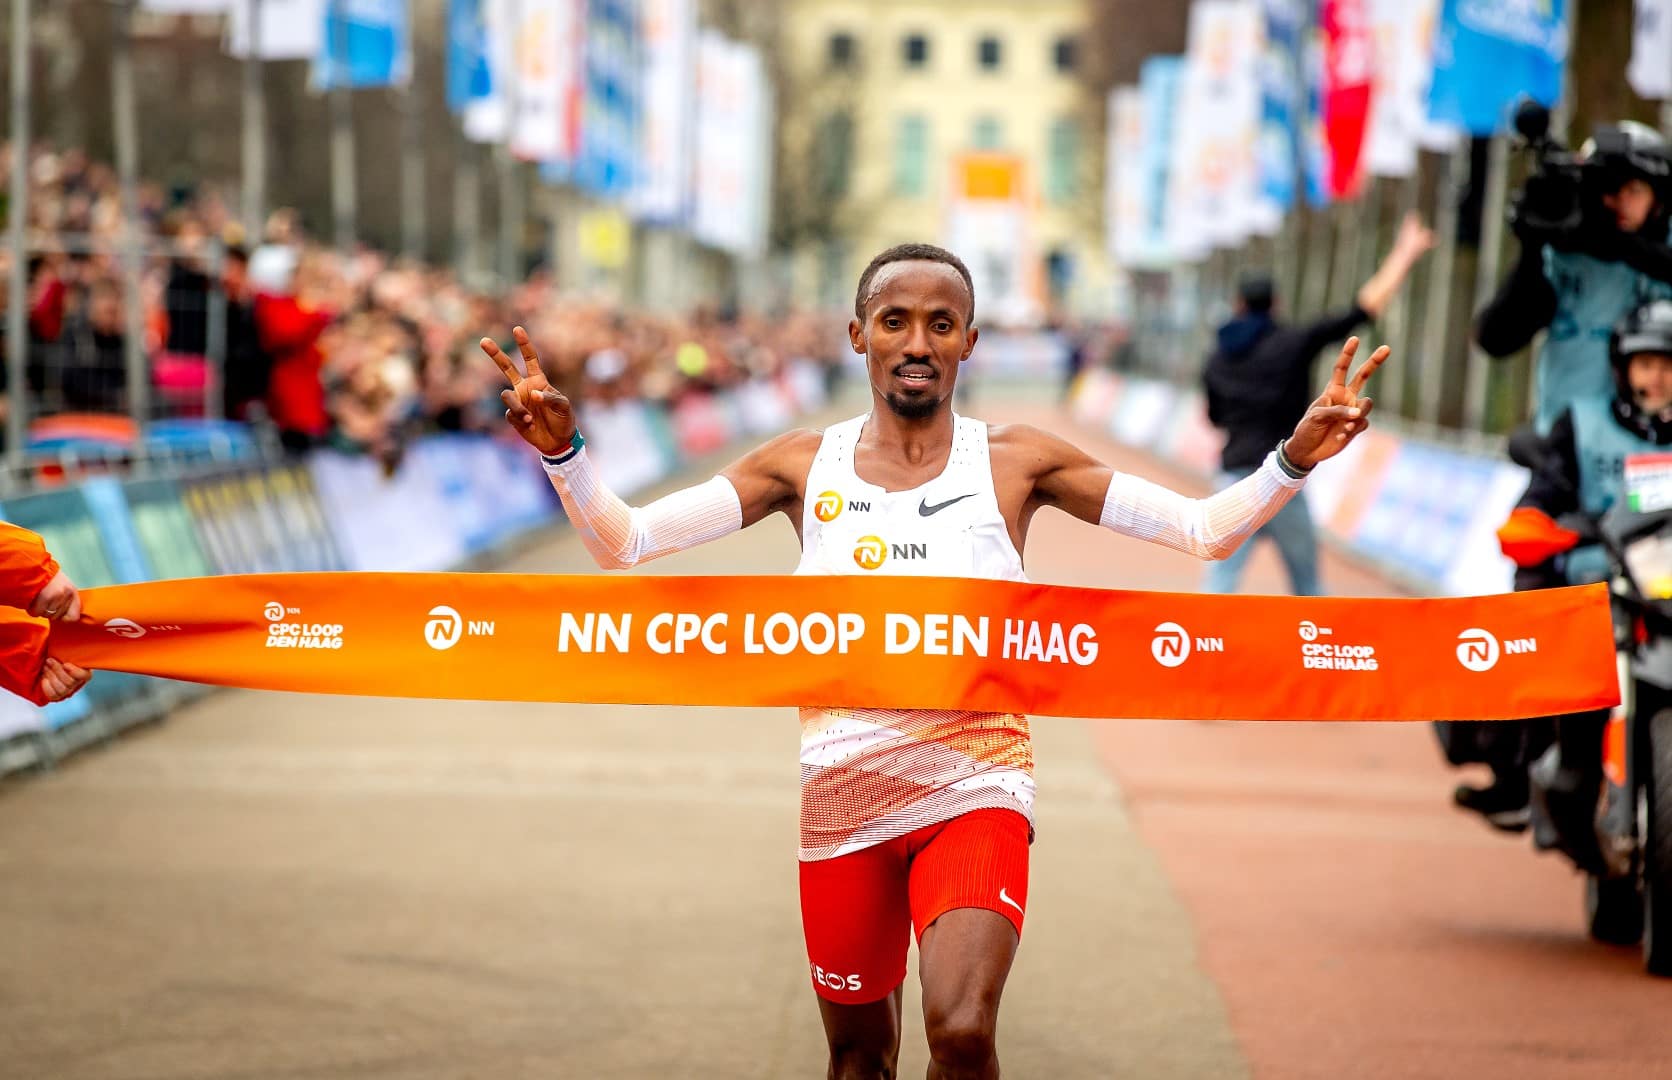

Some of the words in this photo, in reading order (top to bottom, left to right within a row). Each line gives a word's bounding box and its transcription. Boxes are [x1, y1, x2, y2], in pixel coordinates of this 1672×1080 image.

[848, 500, 871, 512] NN
[891, 543, 928, 560] NN
[268, 623, 301, 636] CPC
[302, 623, 344, 637] LOOP
[468, 621, 495, 636] NN
[265, 636, 298, 648] DEN
[298, 637, 343, 650] HAAG
[558, 612, 632, 653] NN
[646, 612, 728, 655] CPC
[744, 612, 866, 655] LOOP
[885, 614, 990, 658] DEN
[1001, 618, 1099, 666] HAAG
[1195, 637, 1224, 652] NN
[1503, 637, 1537, 655] NN
[1301, 643, 1334, 657] CPC
[1334, 645, 1375, 659] LOOP
[1303, 656, 1334, 669] DEN
[1334, 658, 1379, 671] HAAG
